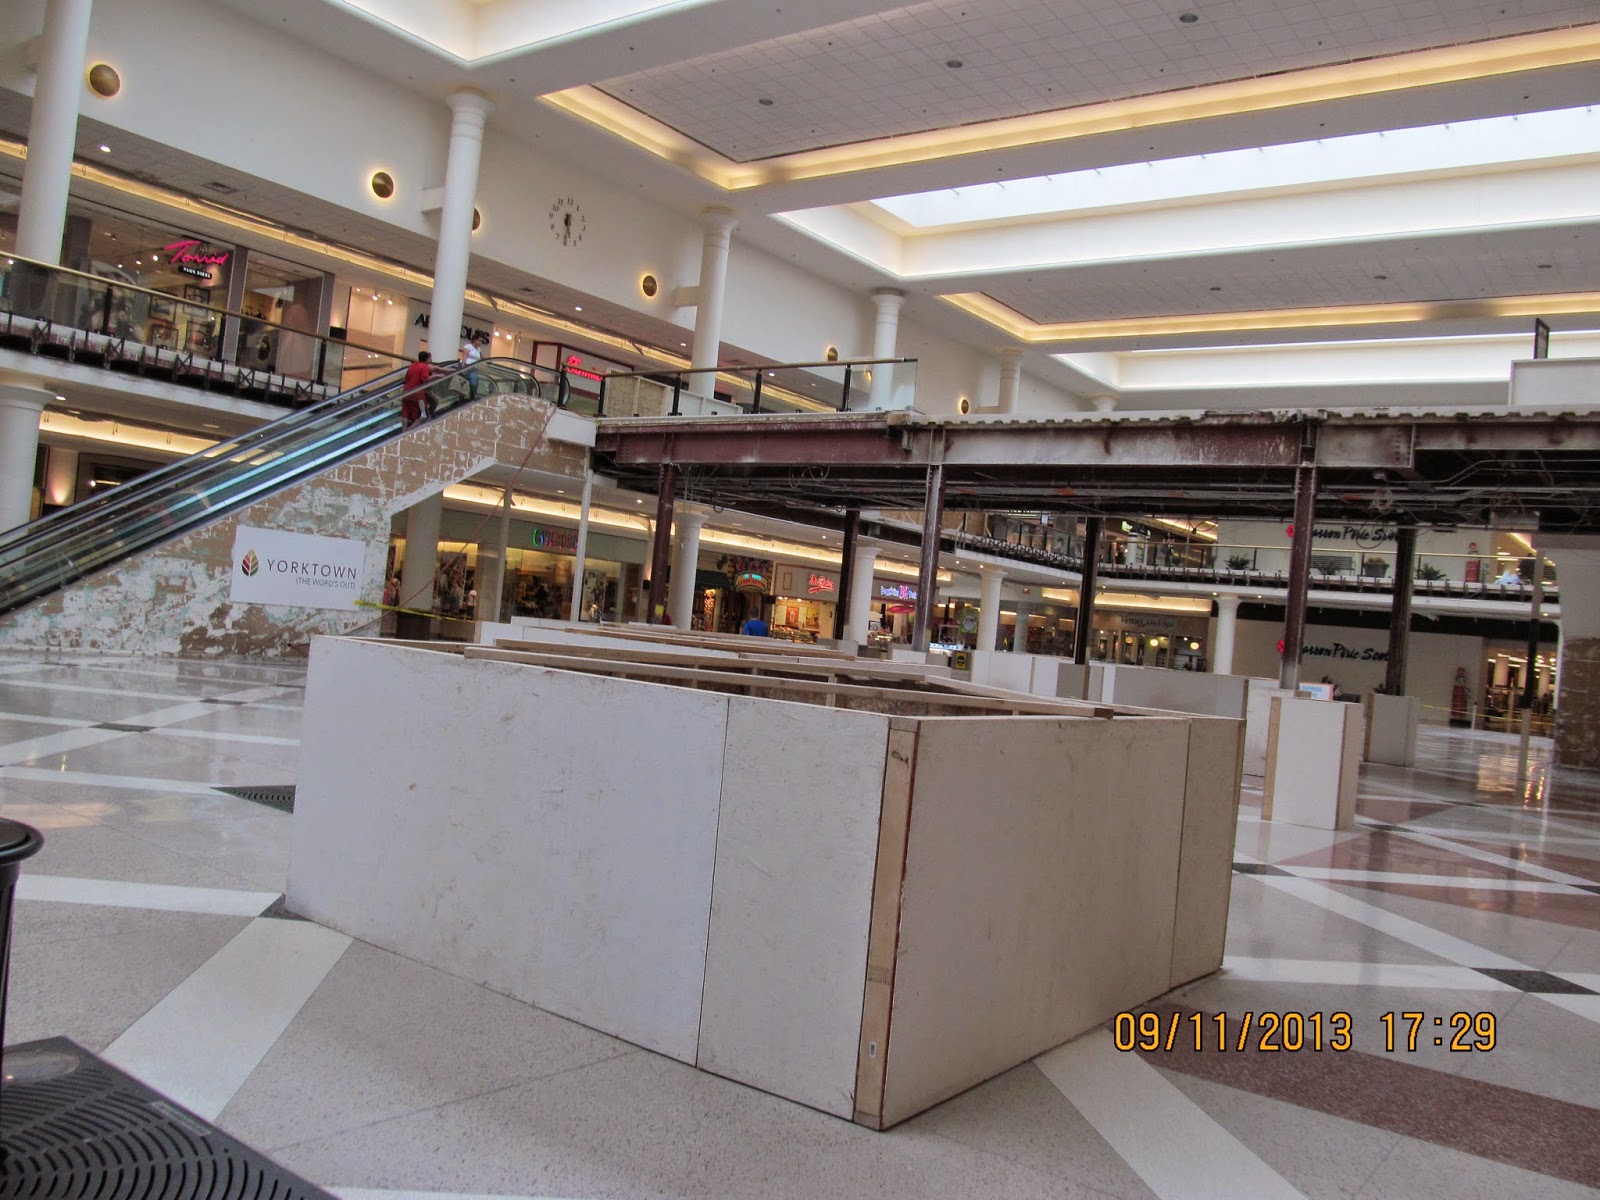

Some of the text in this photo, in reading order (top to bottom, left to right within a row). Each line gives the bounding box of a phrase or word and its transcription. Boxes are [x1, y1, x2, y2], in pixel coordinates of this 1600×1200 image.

[1311, 528, 1341, 539] arson
[267, 558, 357, 579] YORKTOWN
[296, 577, 356, 590] (THE WORD'S OUT)
[1301, 645, 1331, 656] arson
[1333, 642, 1359, 659] Pirie
